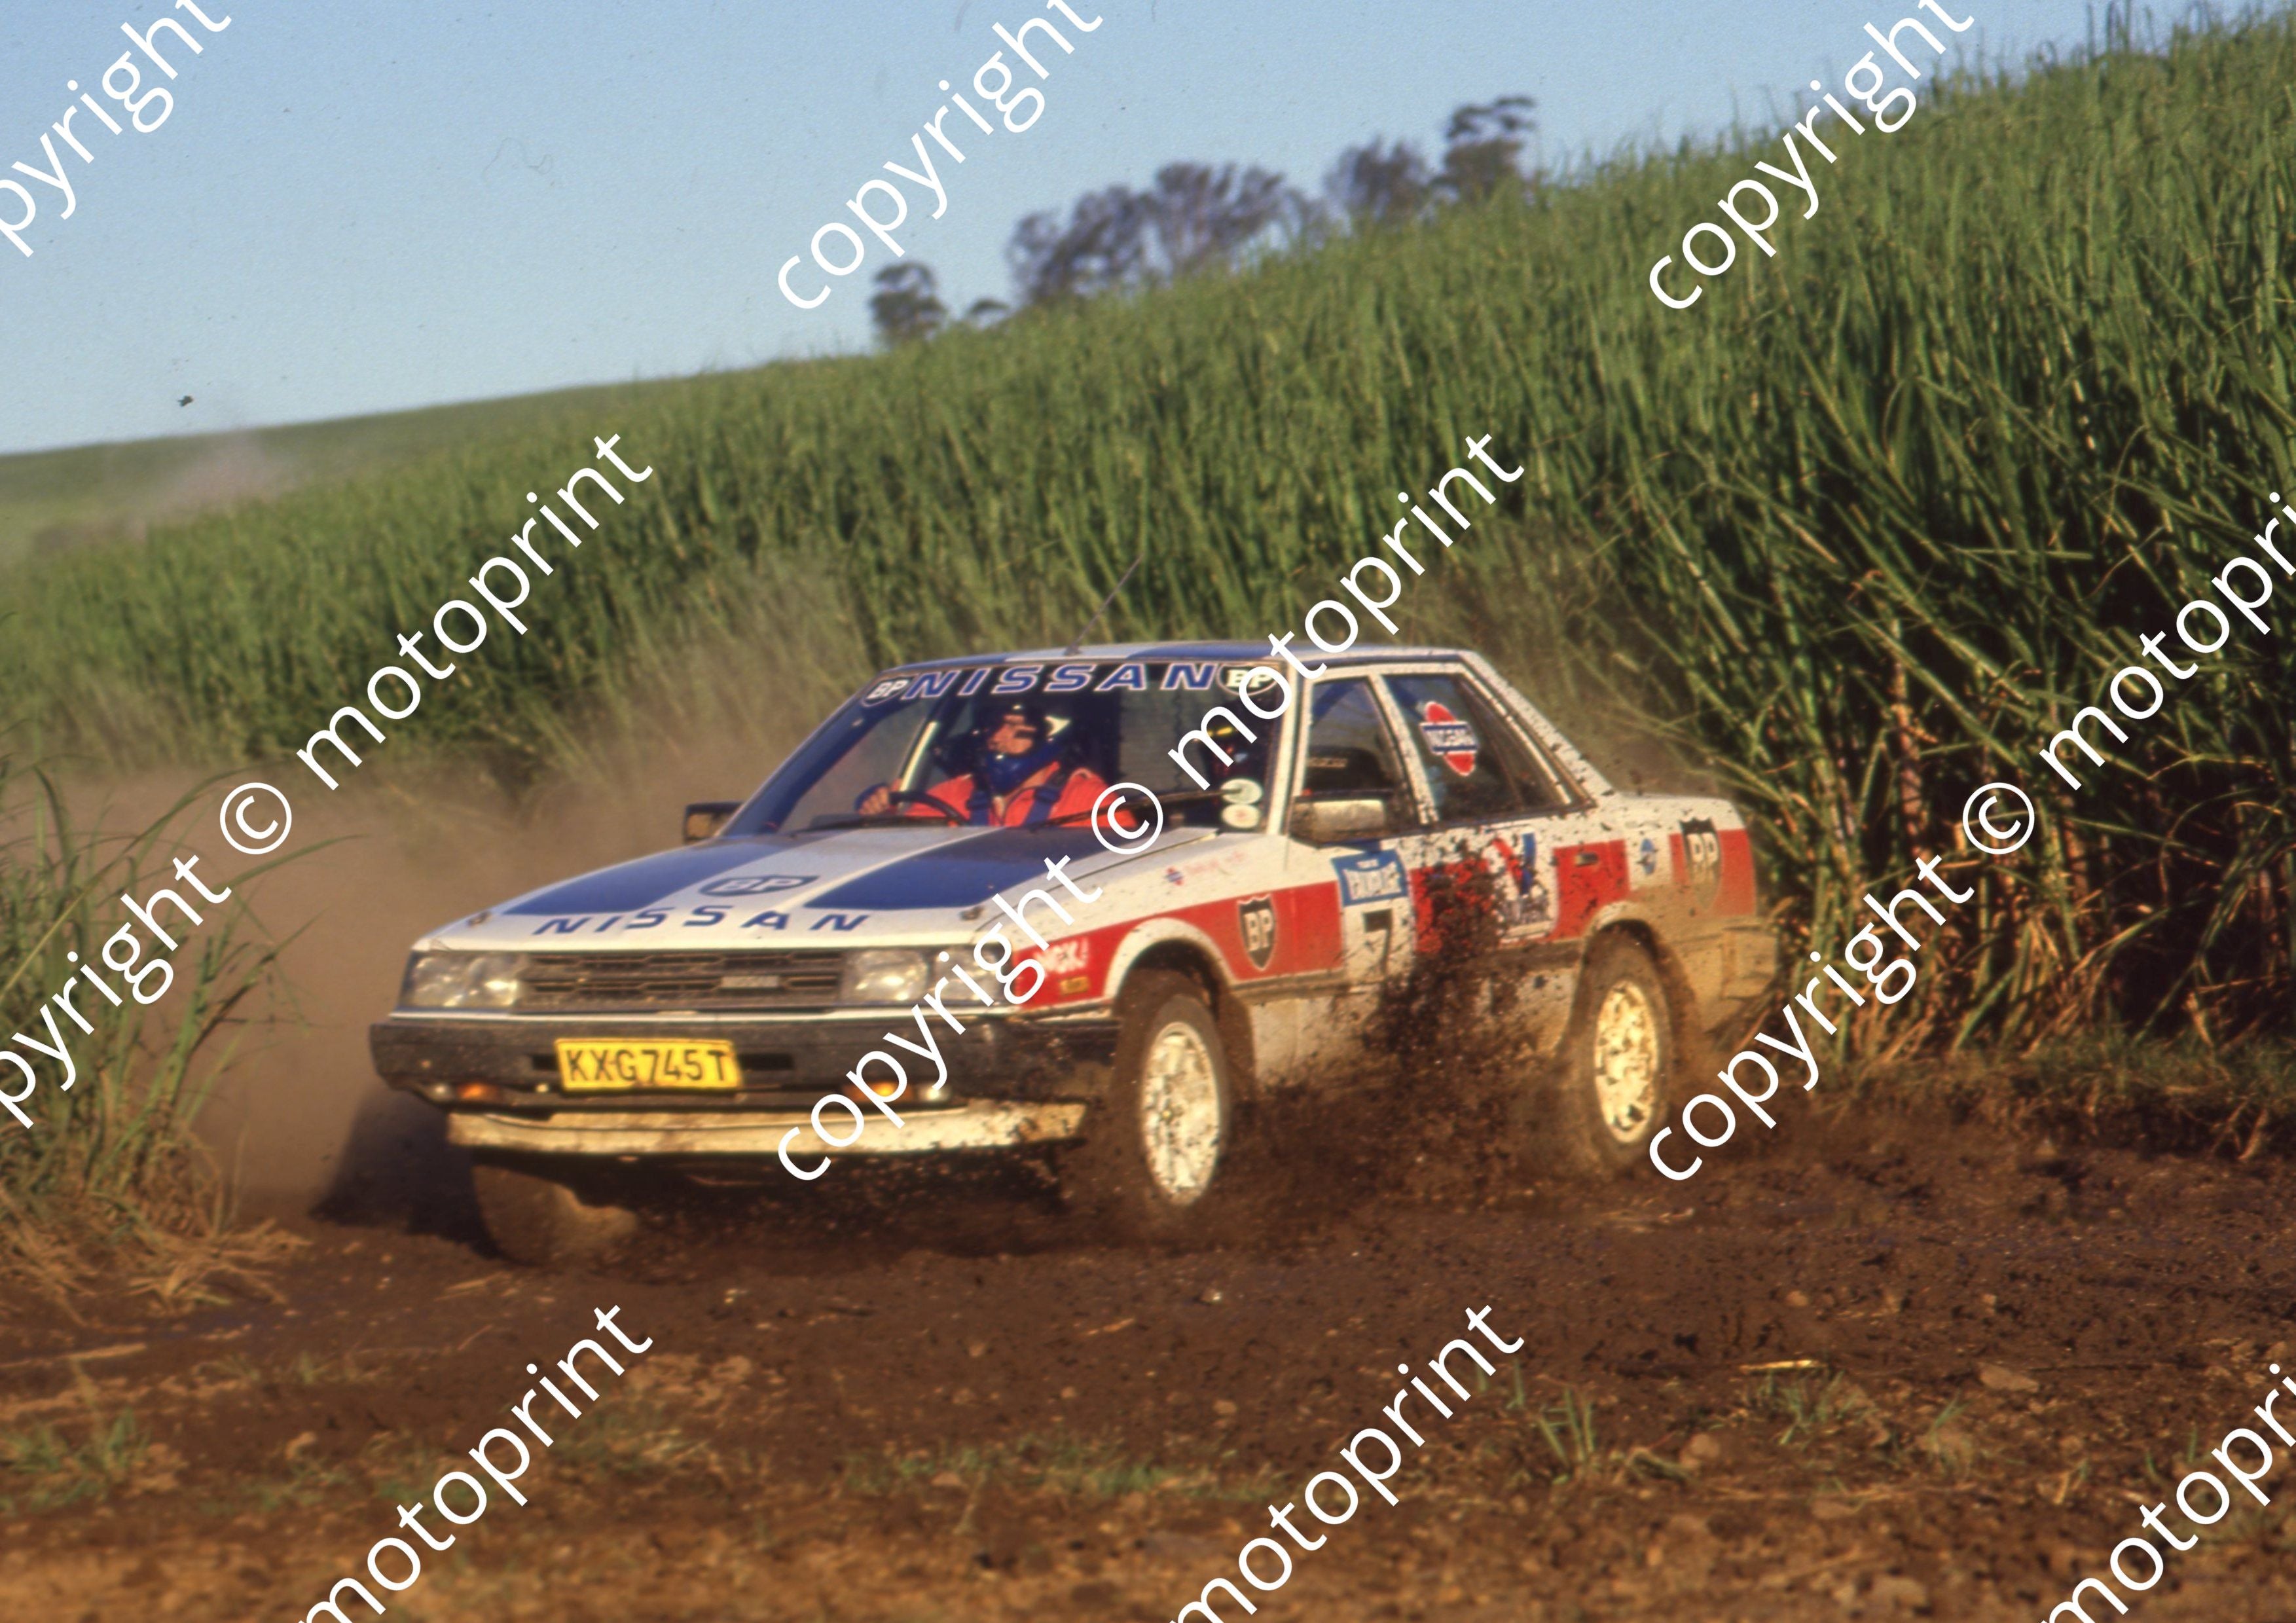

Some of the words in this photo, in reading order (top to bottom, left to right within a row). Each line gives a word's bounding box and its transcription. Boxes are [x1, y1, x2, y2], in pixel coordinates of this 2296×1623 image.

[866, 679, 910, 700] BP
[900, 663, 1219, 701] NISSAN
[1226, 668, 1273, 688] BP
[707, 877, 805, 893] BP
[532, 904, 871, 936] NISSAN
[1244, 909, 1273, 952] BP
[1362, 907, 1393, 977] 7
[566, 1049, 727, 1083] KXG745T
